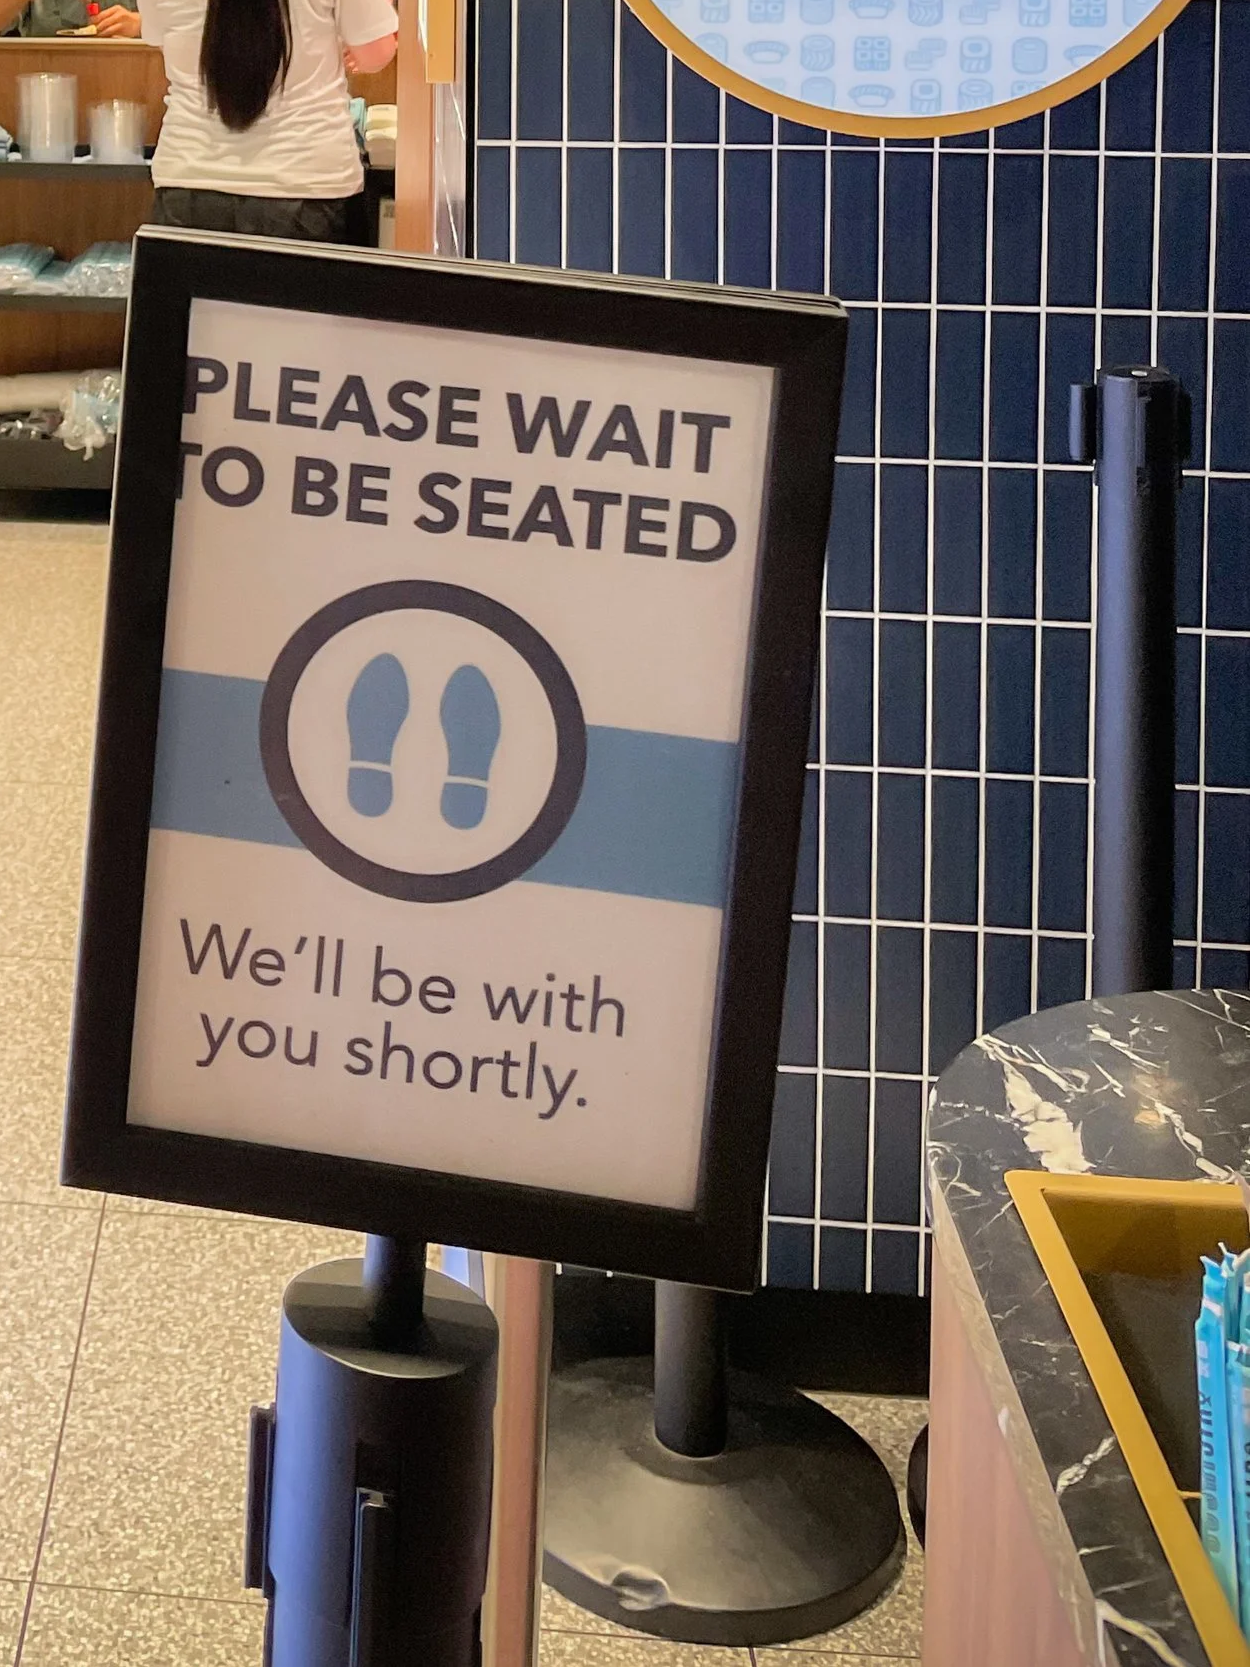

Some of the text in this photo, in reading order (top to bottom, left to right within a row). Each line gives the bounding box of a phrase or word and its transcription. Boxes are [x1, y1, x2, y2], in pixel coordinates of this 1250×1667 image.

[182, 356, 731, 473] PLEASE WAIT
[291, 456, 391, 526] BE
[413, 471, 737, 563] SEATED
[371, 945, 456, 1015] be
[483, 973, 625, 1038] with
[196, 1012, 588, 1121] you shortly.
